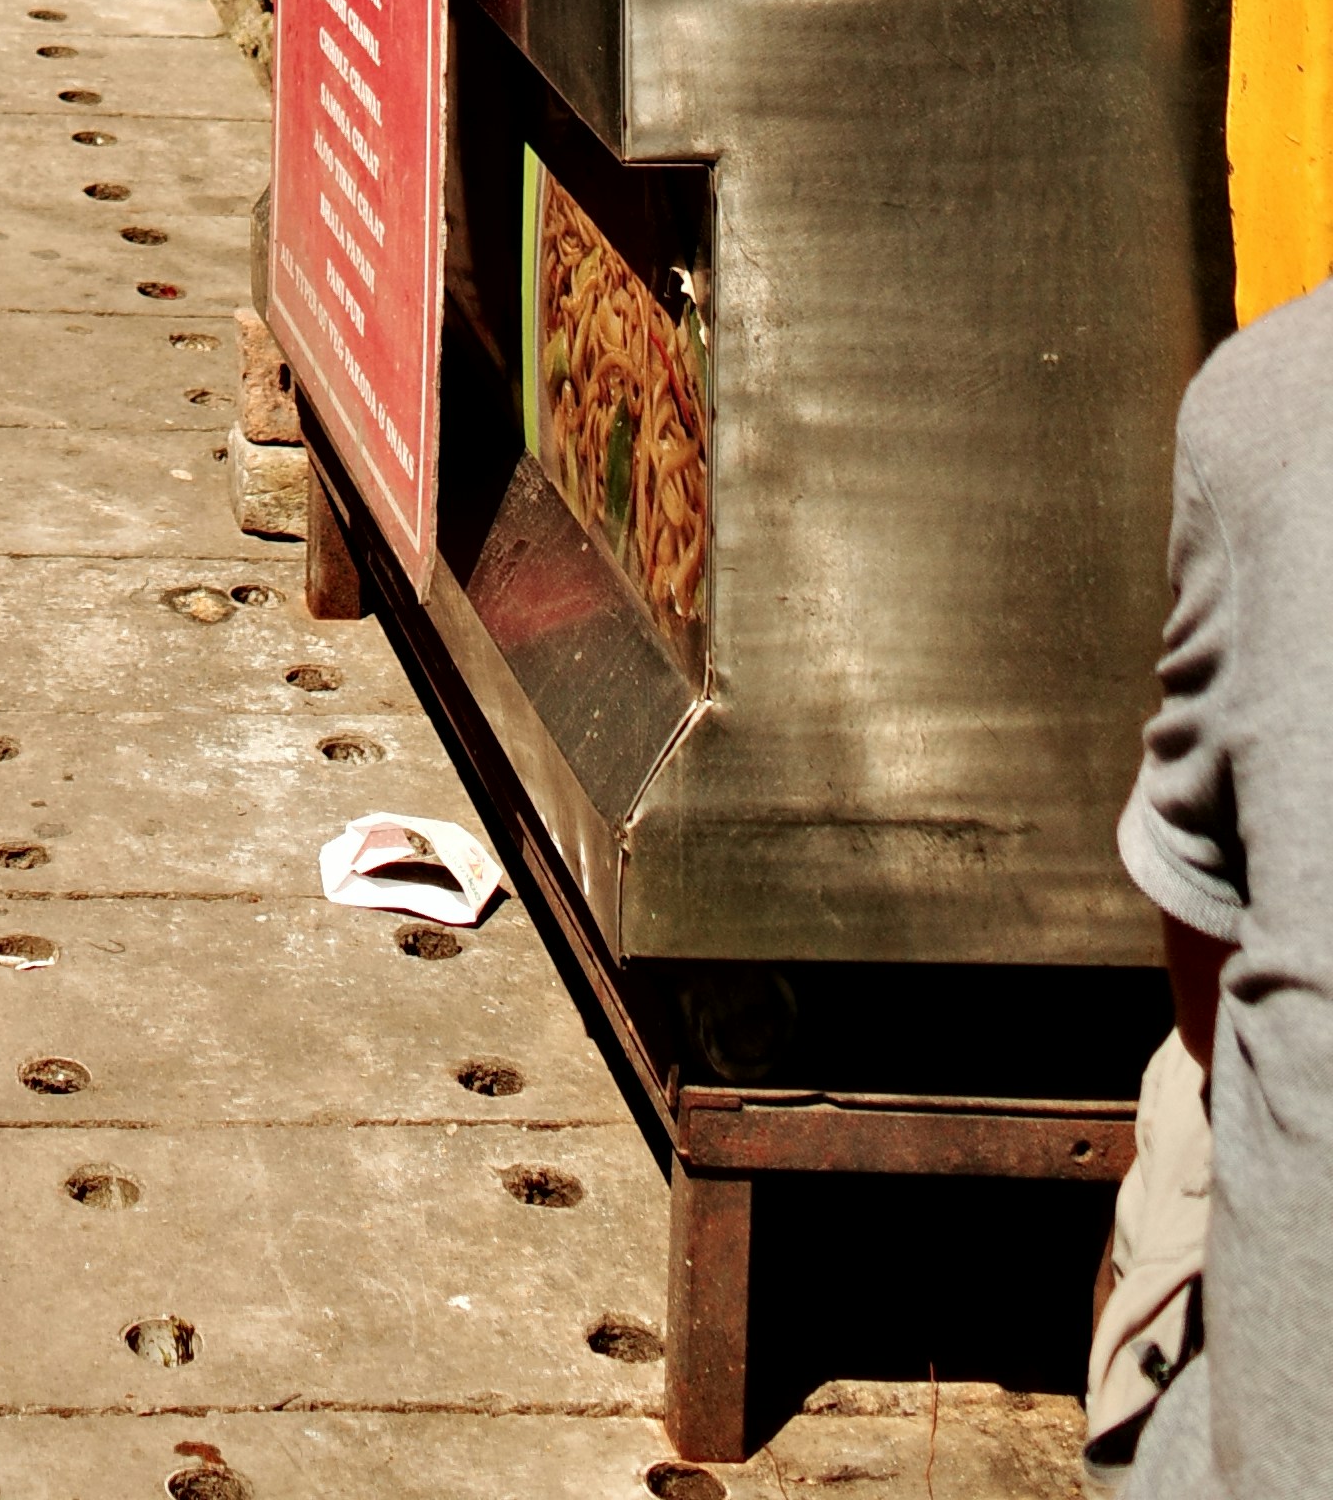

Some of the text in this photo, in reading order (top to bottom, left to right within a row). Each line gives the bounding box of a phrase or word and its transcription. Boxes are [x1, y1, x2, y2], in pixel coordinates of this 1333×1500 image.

[319, 22, 382, 131] CHHOLE CHAWAL
[347, 3, 380, 70] CHAWAL
[320, 79, 379, 185] SAMOSA CHAAT
[313, 124, 384, 252] ALOO TIKKI CHAAT
[345, 228, 374, 297] PAPADI
[345, 284, 364, 340] PURI
[328, 315, 344, 368] VEG
[344, 341, 376, 422] PAKODA
[385, 407, 414, 485] SNAKS
